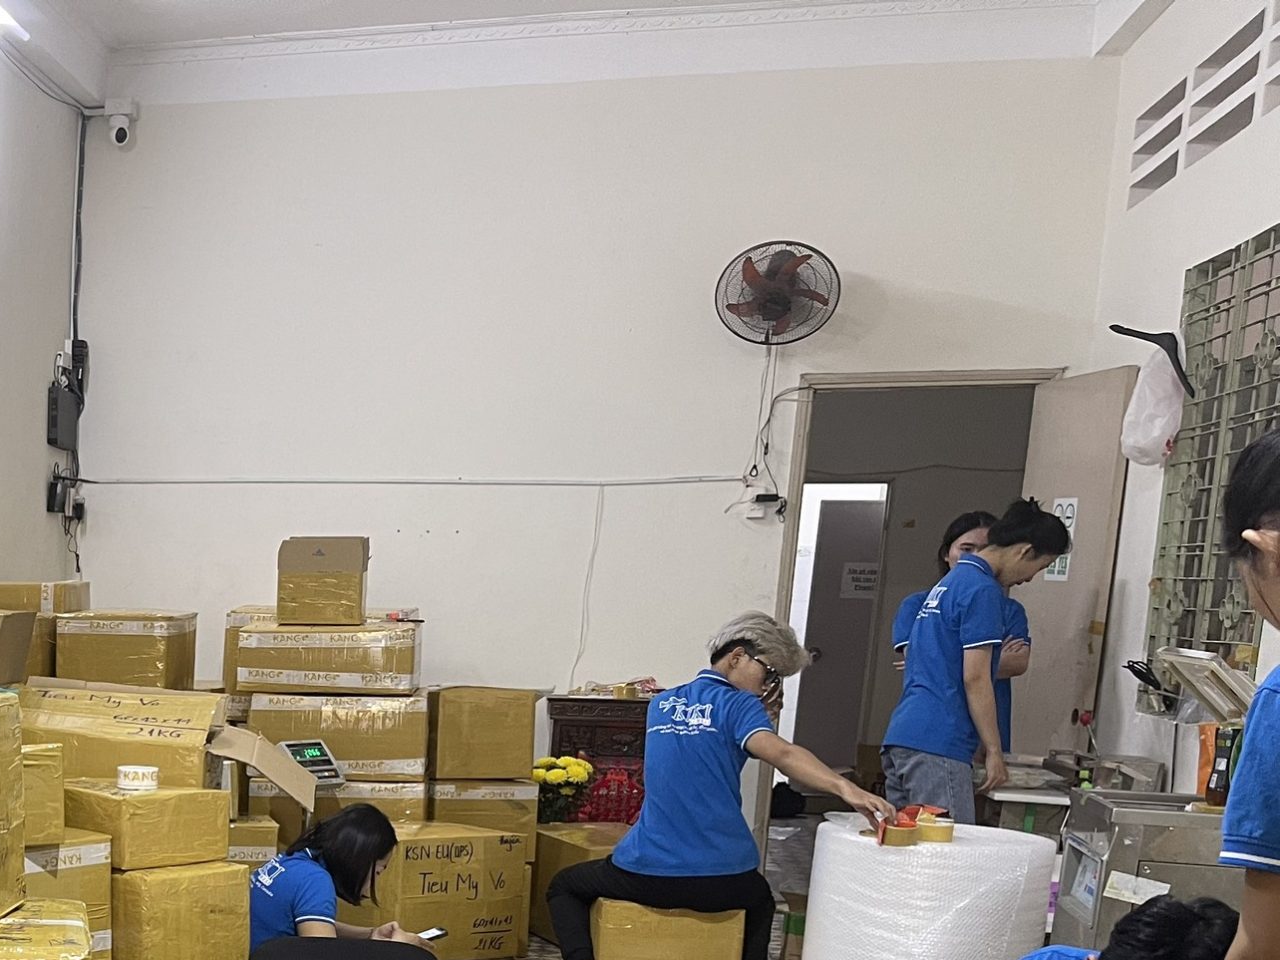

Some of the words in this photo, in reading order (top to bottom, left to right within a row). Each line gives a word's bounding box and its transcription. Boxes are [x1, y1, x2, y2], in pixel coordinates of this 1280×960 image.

[89, 694, 121, 708] My
[405, 845, 430, 861] KSN
[419, 872, 449, 895] Tieu
[455, 873, 479, 900] My
[489, 871, 506, 890] Vo
